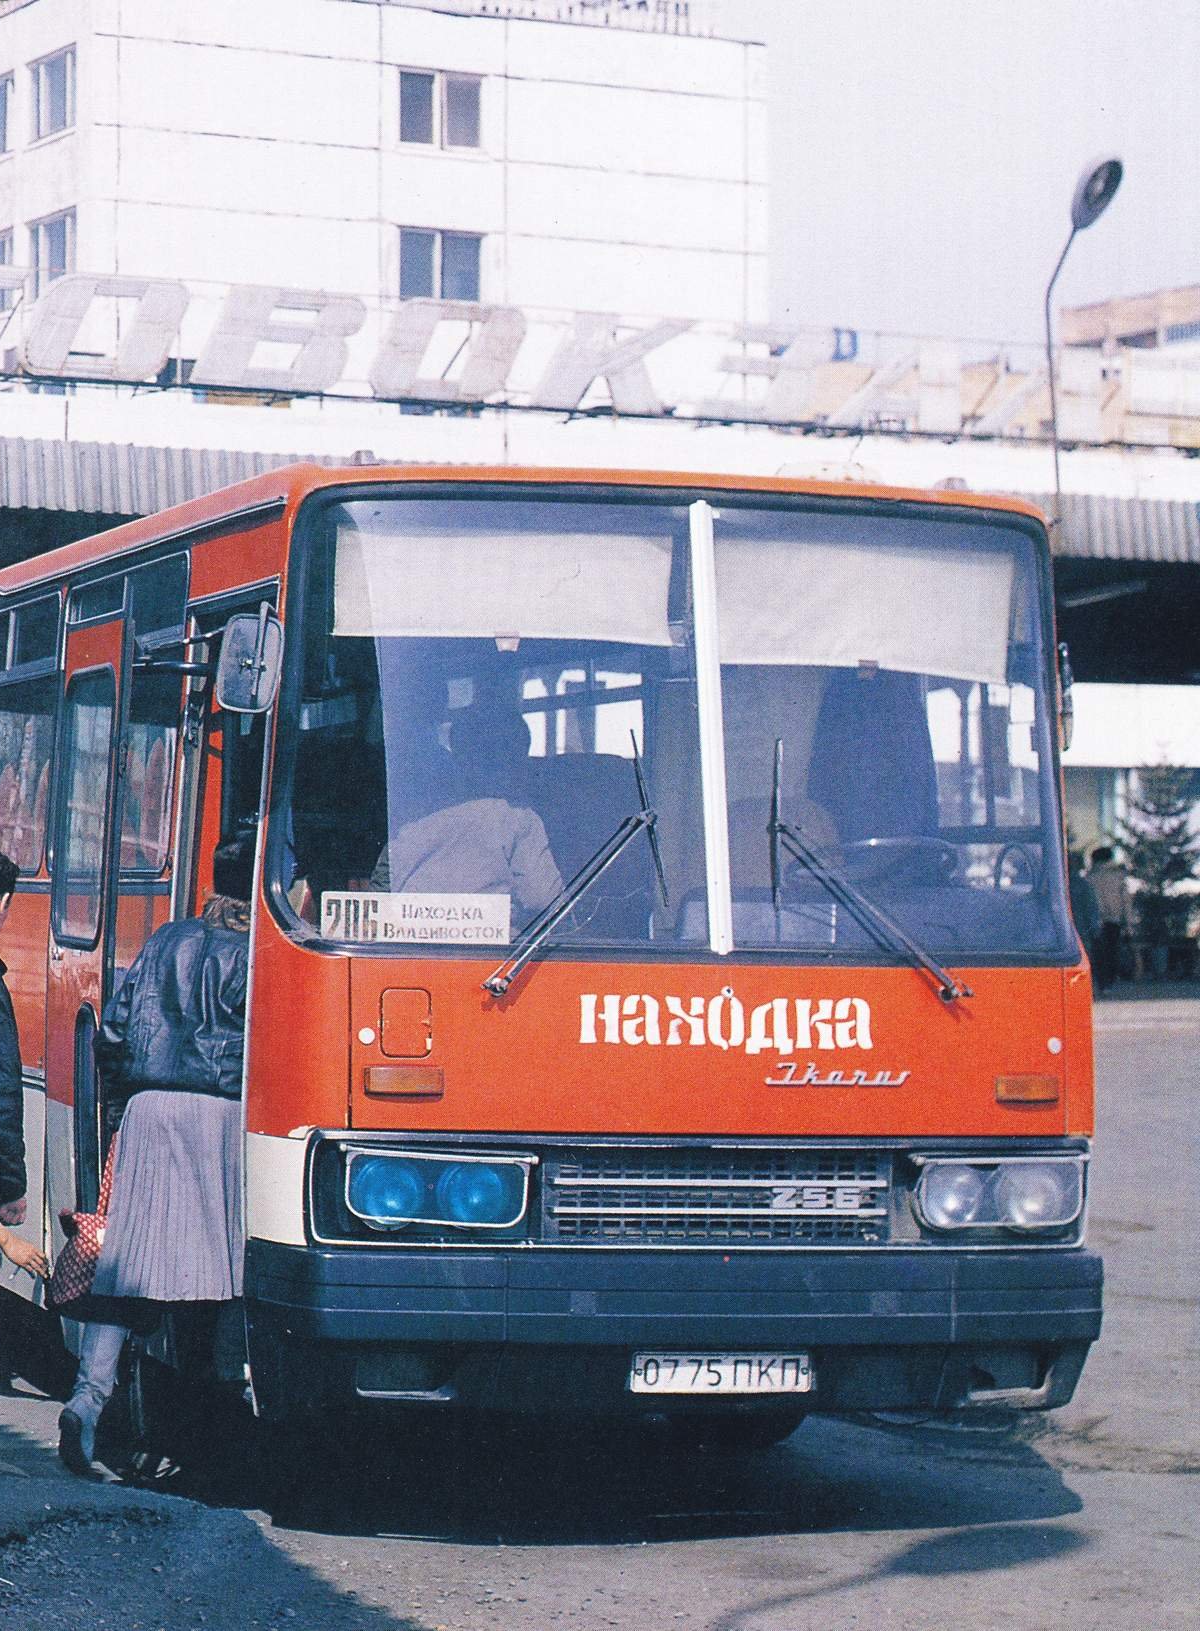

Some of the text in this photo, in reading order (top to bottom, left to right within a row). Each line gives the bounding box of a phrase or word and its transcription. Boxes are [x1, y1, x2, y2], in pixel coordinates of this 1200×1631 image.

[764, 1062, 912, 1086] Ikarus
[771, 1187, 861, 1209] 256
[733, 1357, 800, 1387] ПКП
